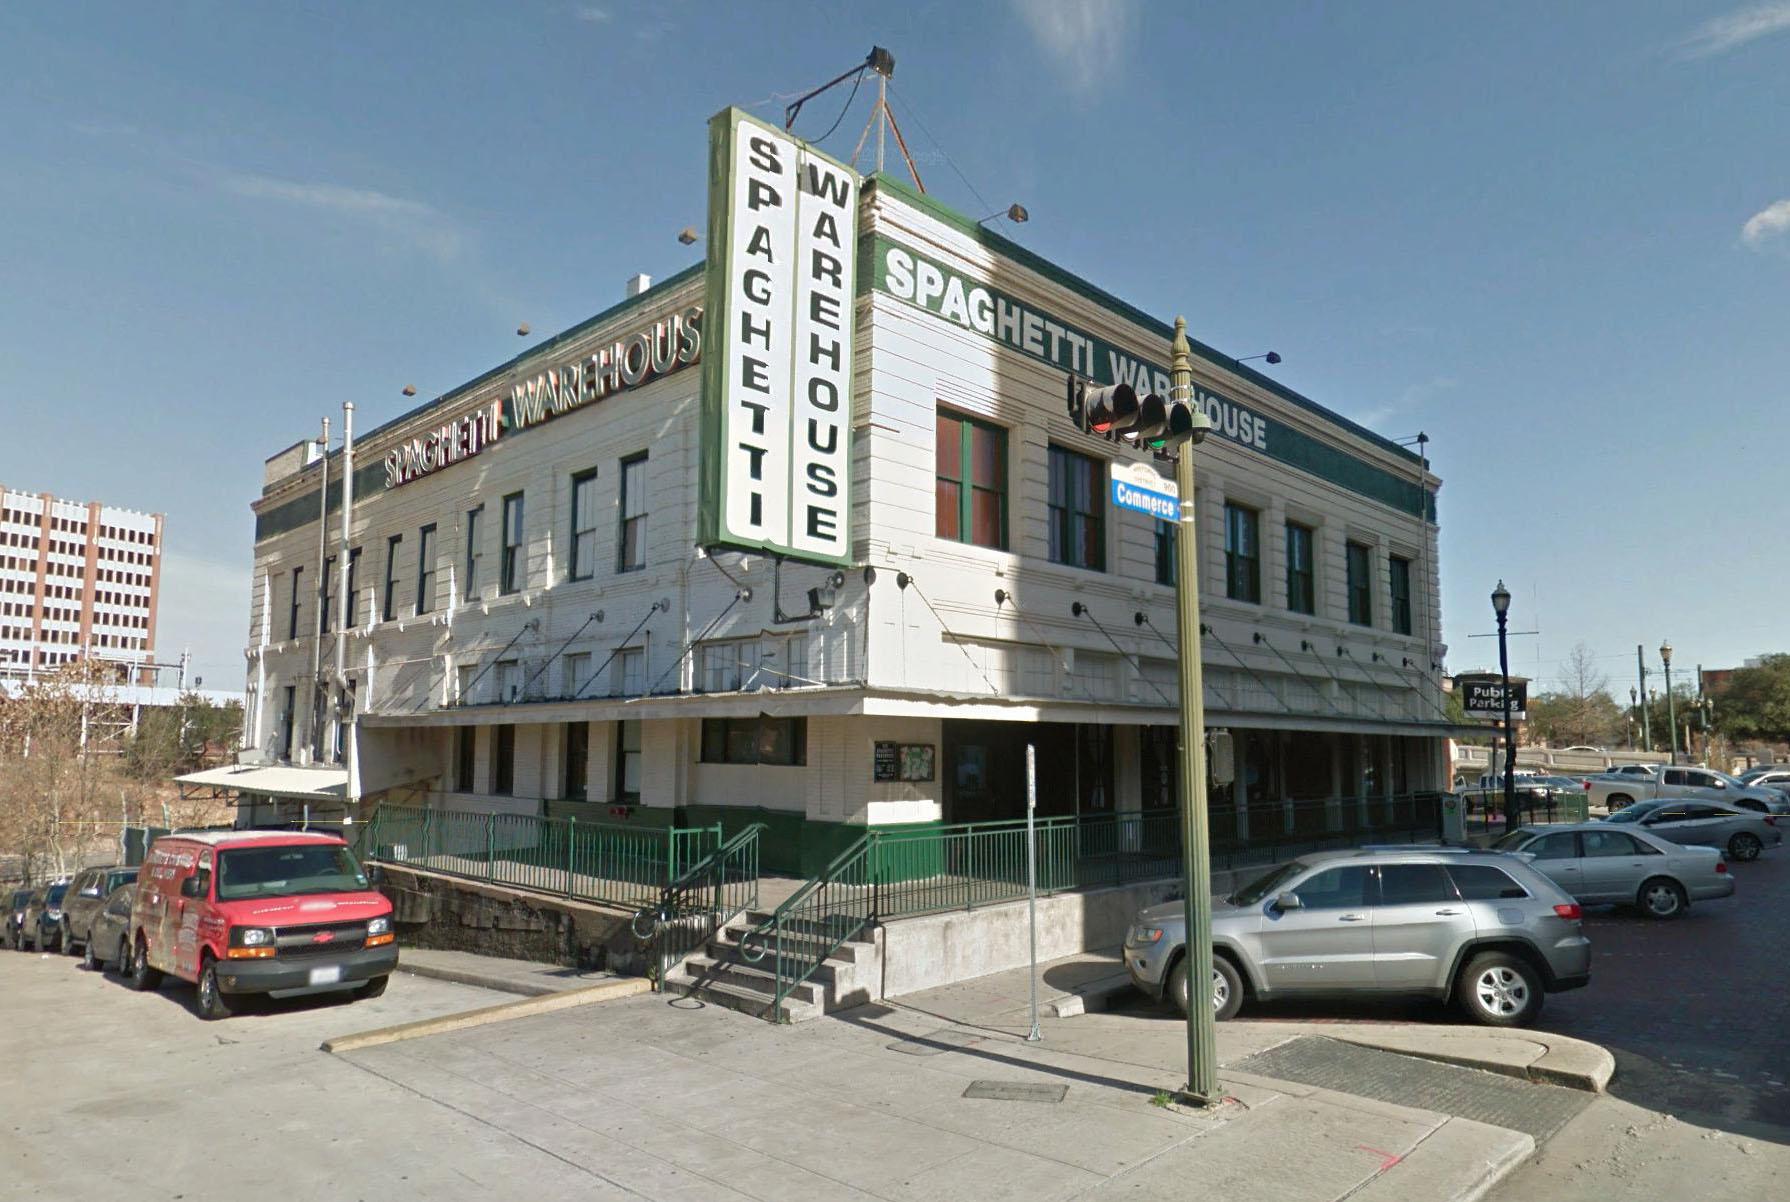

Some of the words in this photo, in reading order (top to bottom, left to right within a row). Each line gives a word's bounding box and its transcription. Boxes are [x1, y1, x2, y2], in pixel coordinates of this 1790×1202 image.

[385, 398, 502, 488] SPAGHETTI
[511, 306, 705, 429] WAREHOUS
[739, 137, 782, 527] SPAGHETTI
[806, 162, 849, 543] WAREHOUSE
[886, 247, 1095, 378] SPAGHETTI
[1109, 350, 1267, 450] WAROUSE
[1117, 483, 1175, 517] Commerce
[1470, 699, 1519, 710] Parkig
[1474, 687, 1513, 698] Publ
